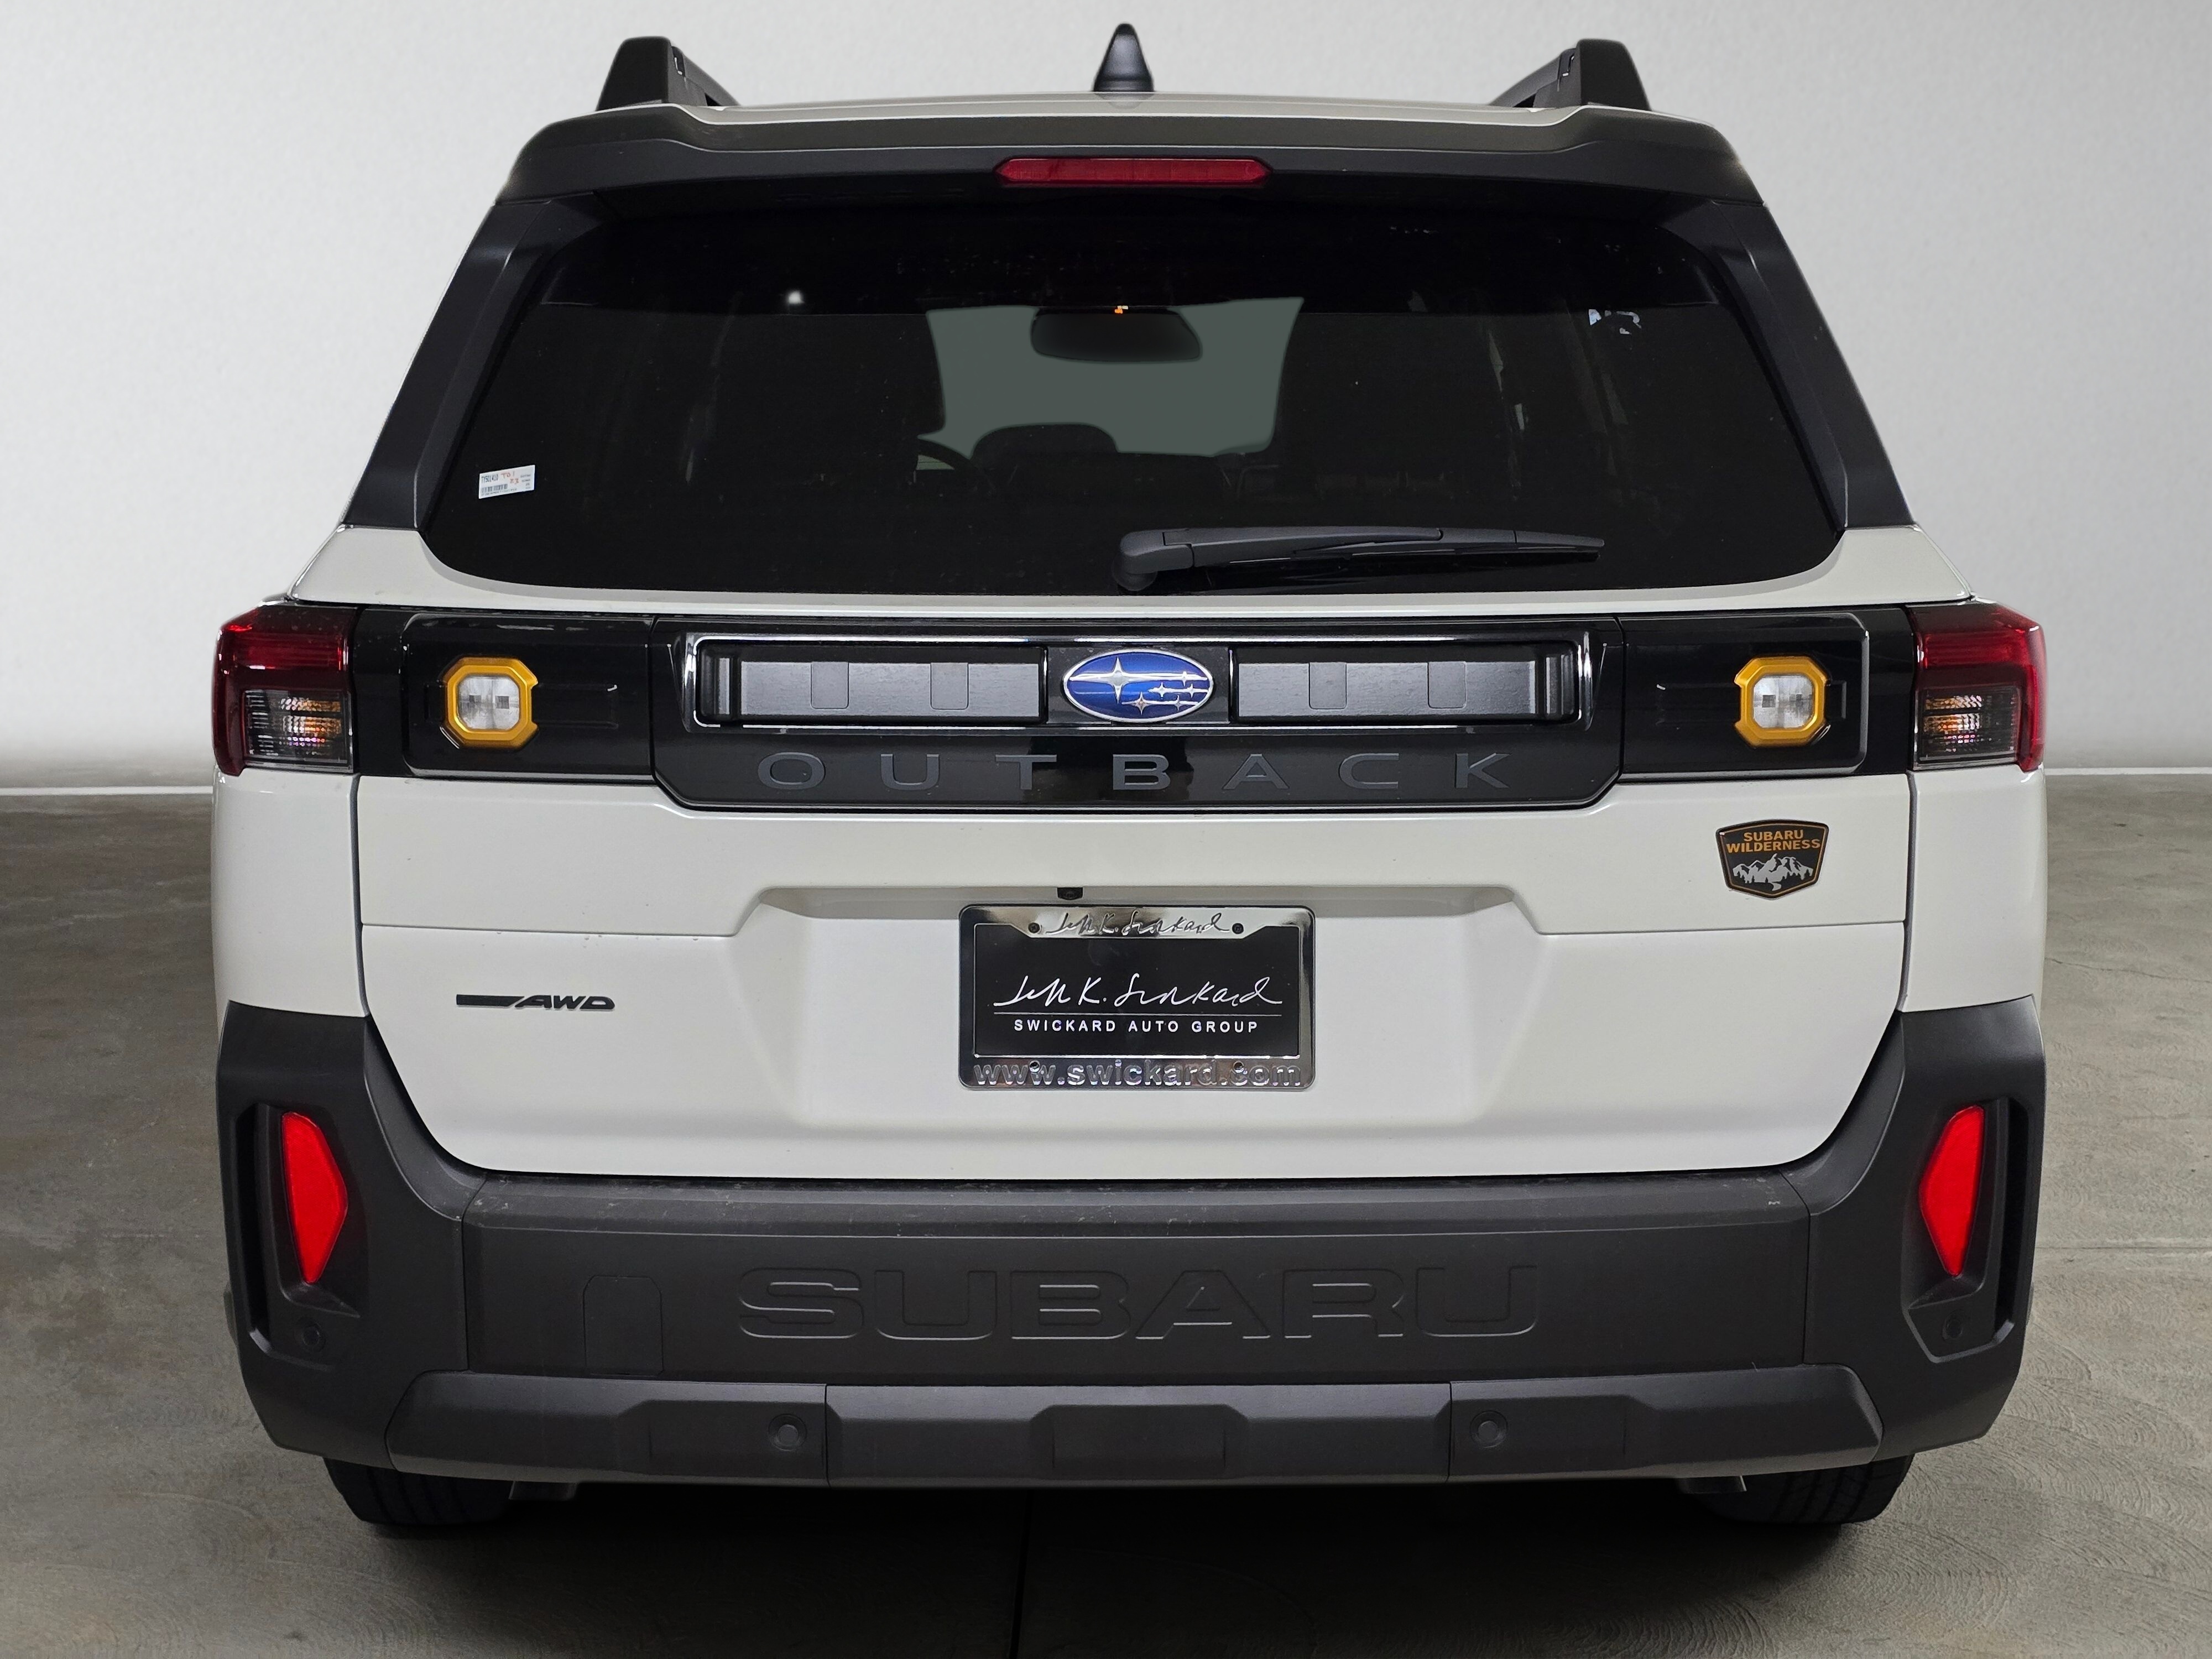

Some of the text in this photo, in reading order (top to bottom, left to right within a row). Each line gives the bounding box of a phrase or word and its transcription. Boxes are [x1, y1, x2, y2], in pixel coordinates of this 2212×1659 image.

[757, 751, 1510, 791] OUTBACK
[1743, 830, 1804, 842] SUBARU
[1726, 838, 1821, 853] WILDERNESS
[514, 994, 615, 1010] AWD
[1014, 1019, 1259, 1034] SWICKARD AUTO GROUP
[973, 1058, 1302, 1087] www.swickard.com
[738, 1266, 1538, 1340] SUBARU
